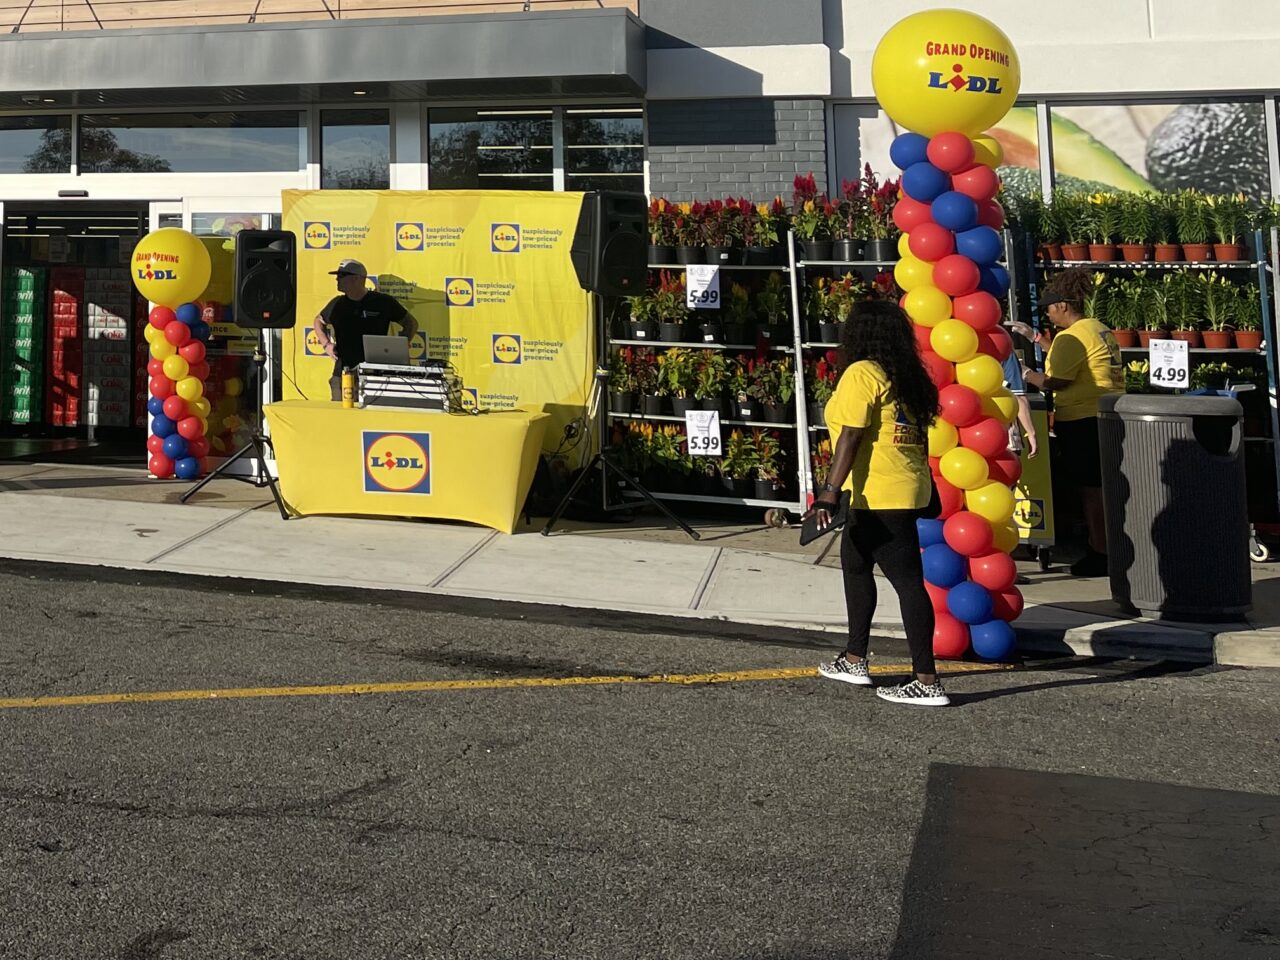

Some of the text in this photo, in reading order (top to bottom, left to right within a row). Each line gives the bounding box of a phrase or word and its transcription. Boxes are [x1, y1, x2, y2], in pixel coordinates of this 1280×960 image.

[926, 41, 1010, 67] GRAND OPENING
[689, 290, 718, 303] 5.99
[1153, 367, 1186, 382] 4.99
[690, 436, 719, 449] 5.99
